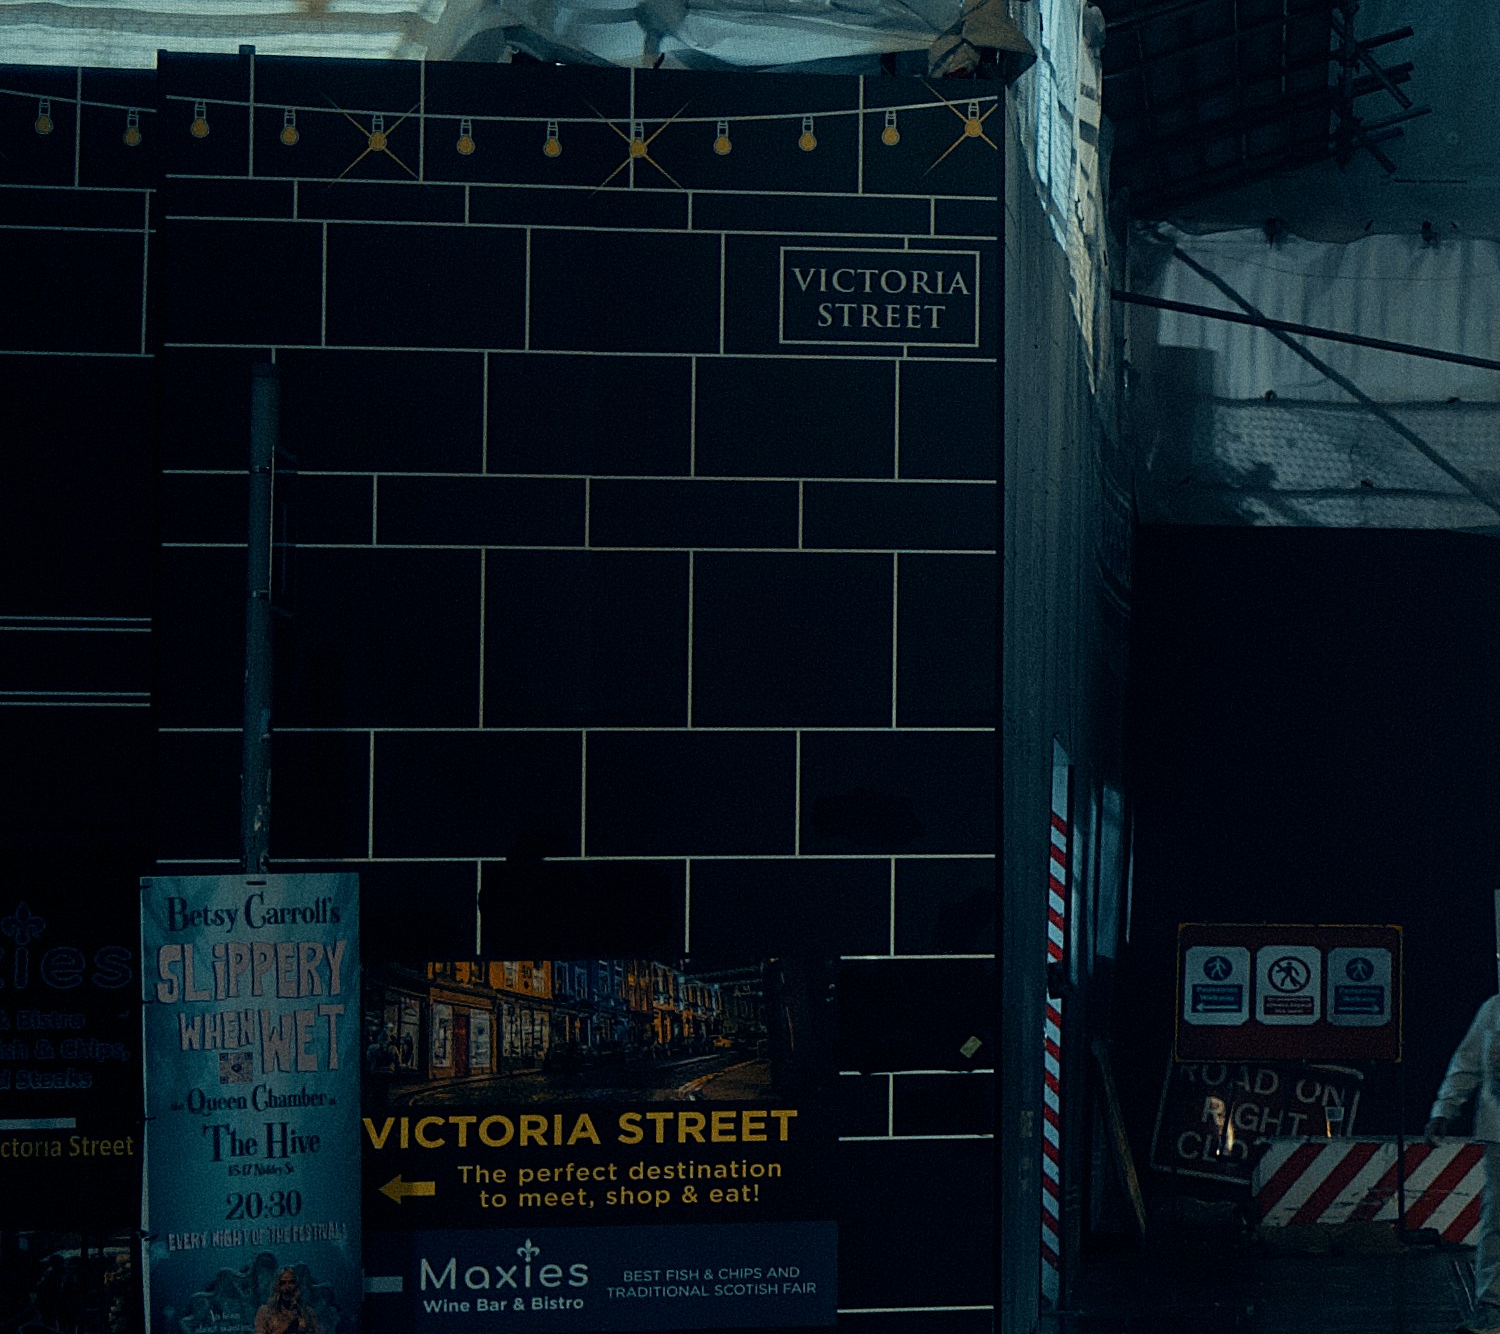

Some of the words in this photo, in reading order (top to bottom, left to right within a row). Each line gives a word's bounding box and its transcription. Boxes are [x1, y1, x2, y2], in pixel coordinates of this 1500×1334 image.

[791, 267, 971, 295] VICTORIA
[817, 302, 946, 329] STREET
[166, 896, 239, 933] Betsy
[33, 1039, 55, 1060] &
[179, 1008, 255, 1051] WHEN
[257, 1004, 345, 1074] WET
[187, 1087, 247, 1117] Queen
[251, 1084, 327, 1112] Chamber
[203, 1123, 258, 1162] The
[264, 1122, 321, 1160] Hive
[362, 1113, 602, 1150] VICTORIA
[617, 1109, 799, 1145] STREET
[68, 1134, 135, 1158] Street
[457, 1164, 508, 1184] The
[518, 1162, 618, 1186] perfect
[627, 1160, 783, 1181] destination
[226, 1190, 302, 1220] 20:30
[479, 1190, 507, 1208] to
[518, 1189, 595, 1209] meet,
[605, 1185, 671, 1208] shop
[681, 1186, 699, 1204] &
[708, 1184, 760, 1203] eat!
[419, 1247, 590, 1291] Maxies
[623, 1270, 662, 1283] BEST
[665, 1268, 699, 1282] FISH
[703, 1268, 715, 1281] &
[718, 1267, 763, 1281] CHIPS
[767, 1266, 801, 1279] AND
[607, 1284, 710, 1299] TRADITIONAL
[713, 1282, 779, 1296] SCOTISH
[782, 1281, 817, 1295] FAIR
[423, 1298, 470, 1314] Wine
[476, 1297, 508, 1313] Bar
[512, 1297, 526, 1312] &
[530, 1296, 584, 1312] Bistro
